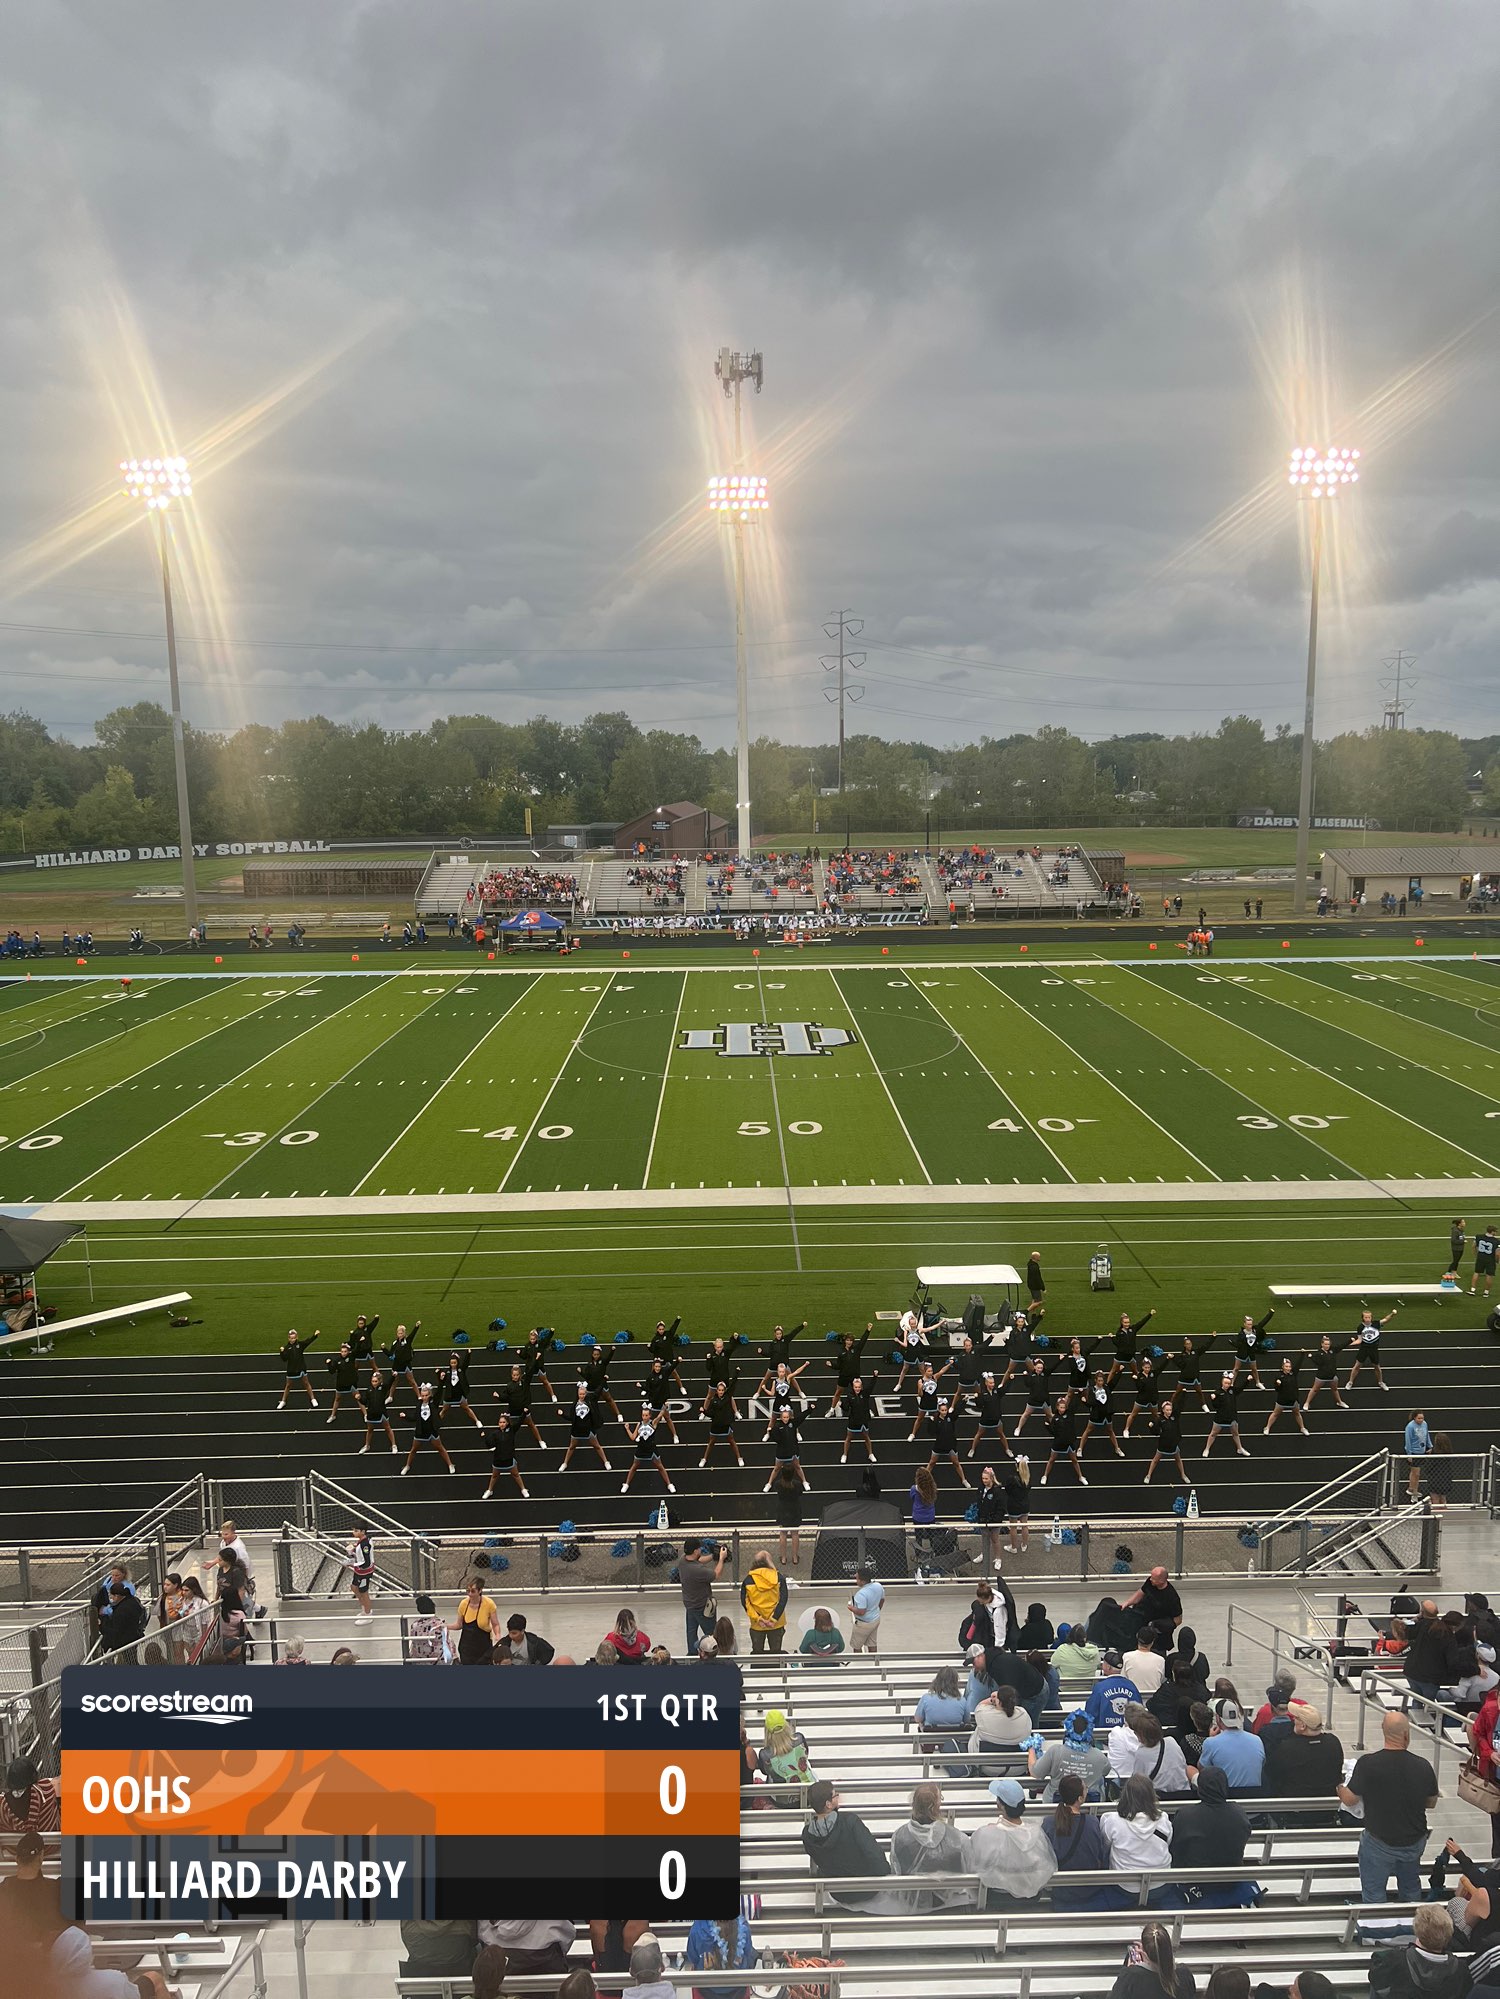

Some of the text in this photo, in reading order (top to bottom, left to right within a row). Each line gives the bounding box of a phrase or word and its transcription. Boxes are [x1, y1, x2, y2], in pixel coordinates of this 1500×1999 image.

[1314, 817, 1365, 828] BASEBALL
[35, 849, 131, 868] HILLIARD
[216, 840, 330, 856] SOFTBALL
[1478, 1240, 1493, 1254] 63
[1103, 1687, 1133, 1699] HILLIARD
